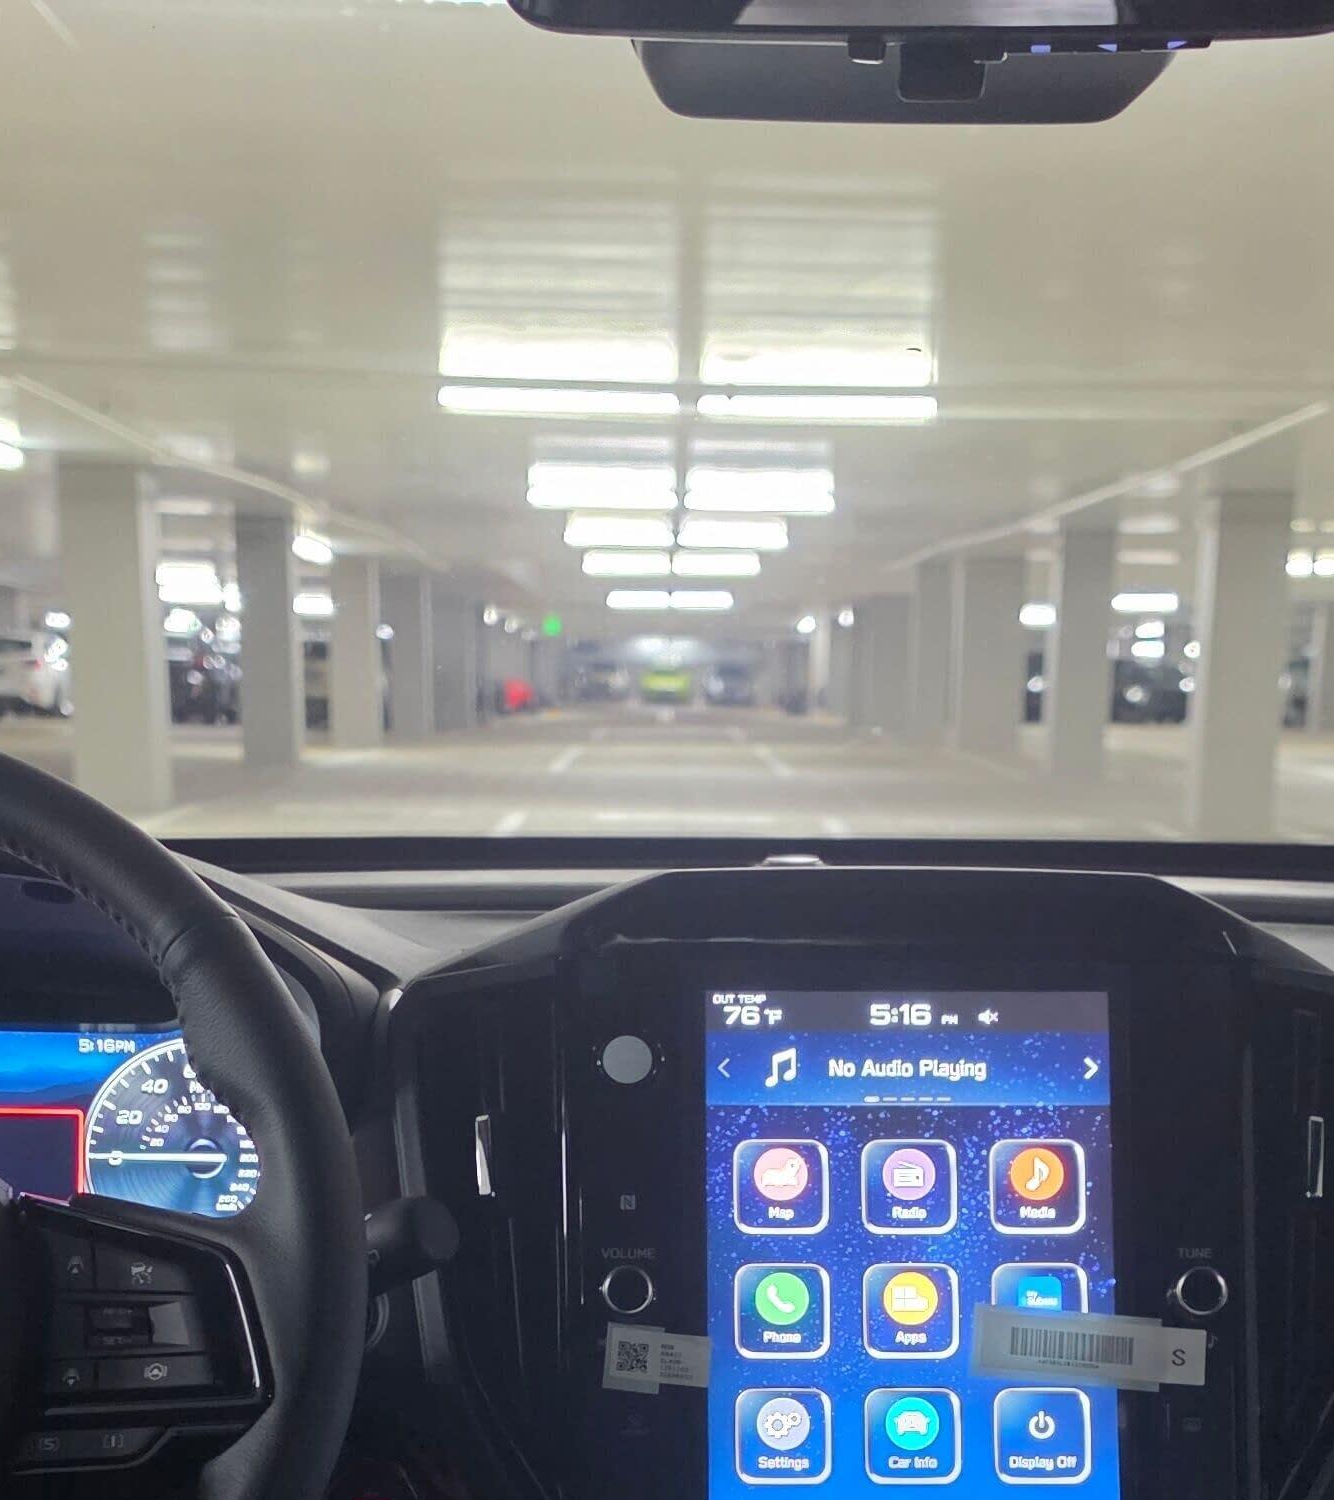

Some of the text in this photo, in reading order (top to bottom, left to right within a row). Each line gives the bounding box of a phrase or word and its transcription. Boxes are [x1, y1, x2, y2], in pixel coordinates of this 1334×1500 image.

[712, 994, 766, 1004] OUT TEMP
[723, 1005, 760, 1026] 76
[870, 1003, 958, 1026] 5:16 PM
[829, 1059, 987, 1081] No Audio Playing
[141, 1079, 168, 1094] 40
[116, 1110, 143, 1125] 20
[768, 1206, 794, 1220] Map
[892, 1206, 927, 1219] Radio
[1019, 1206, 1056, 1219] Media
[600, 1248, 655, 1259] VOLUME
[1178, 1248, 1211, 1259] TUNE
[763, 1331, 801, 1344] Phone
[895, 1331, 927, 1345] Apps
[1172, 1349, 1185, 1366] S
[757, 1456, 809, 1471] Settings
[888, 1456, 937, 1469] Car Info
[1009, 1456, 1077, 1471] Display Off
